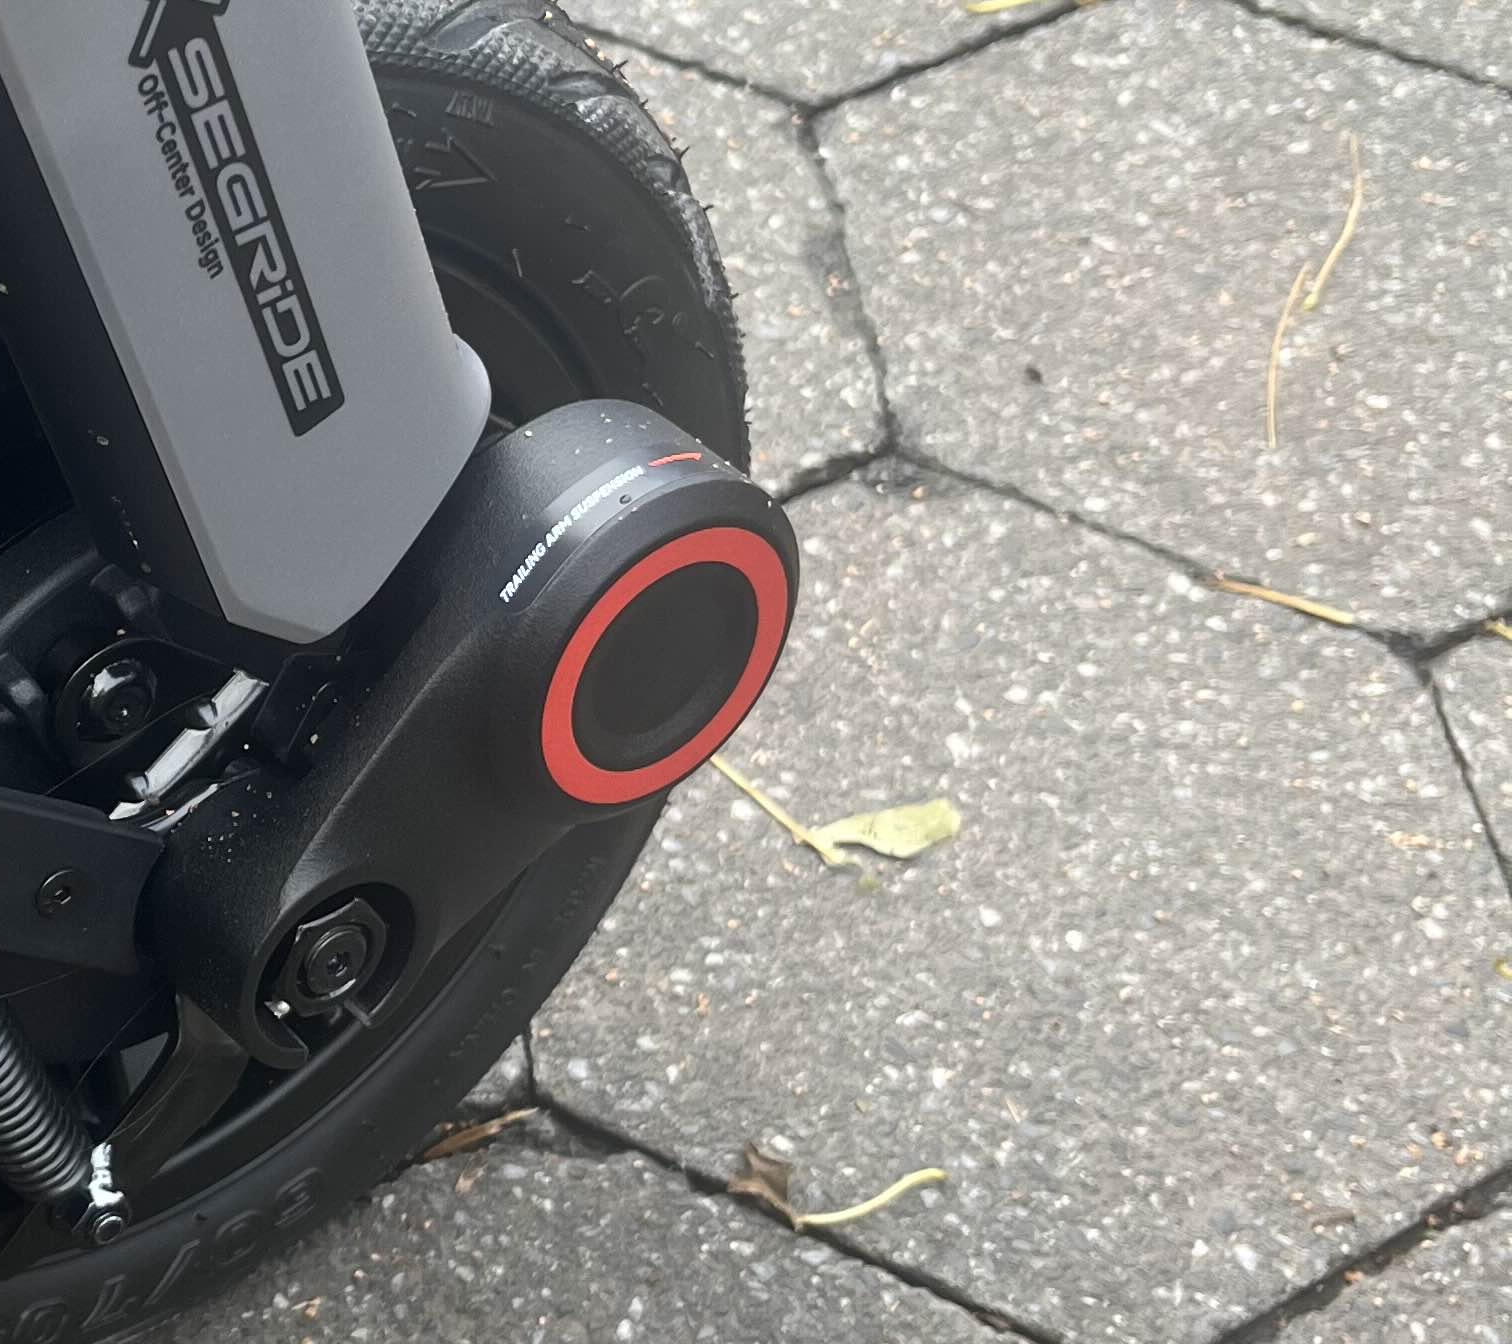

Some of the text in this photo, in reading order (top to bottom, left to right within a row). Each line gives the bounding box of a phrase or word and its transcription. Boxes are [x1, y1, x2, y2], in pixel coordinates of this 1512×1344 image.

[137, 73, 226, 281] Off-Center Design
[499, 465, 644, 603] TRAILING ARM SUSPENSION
